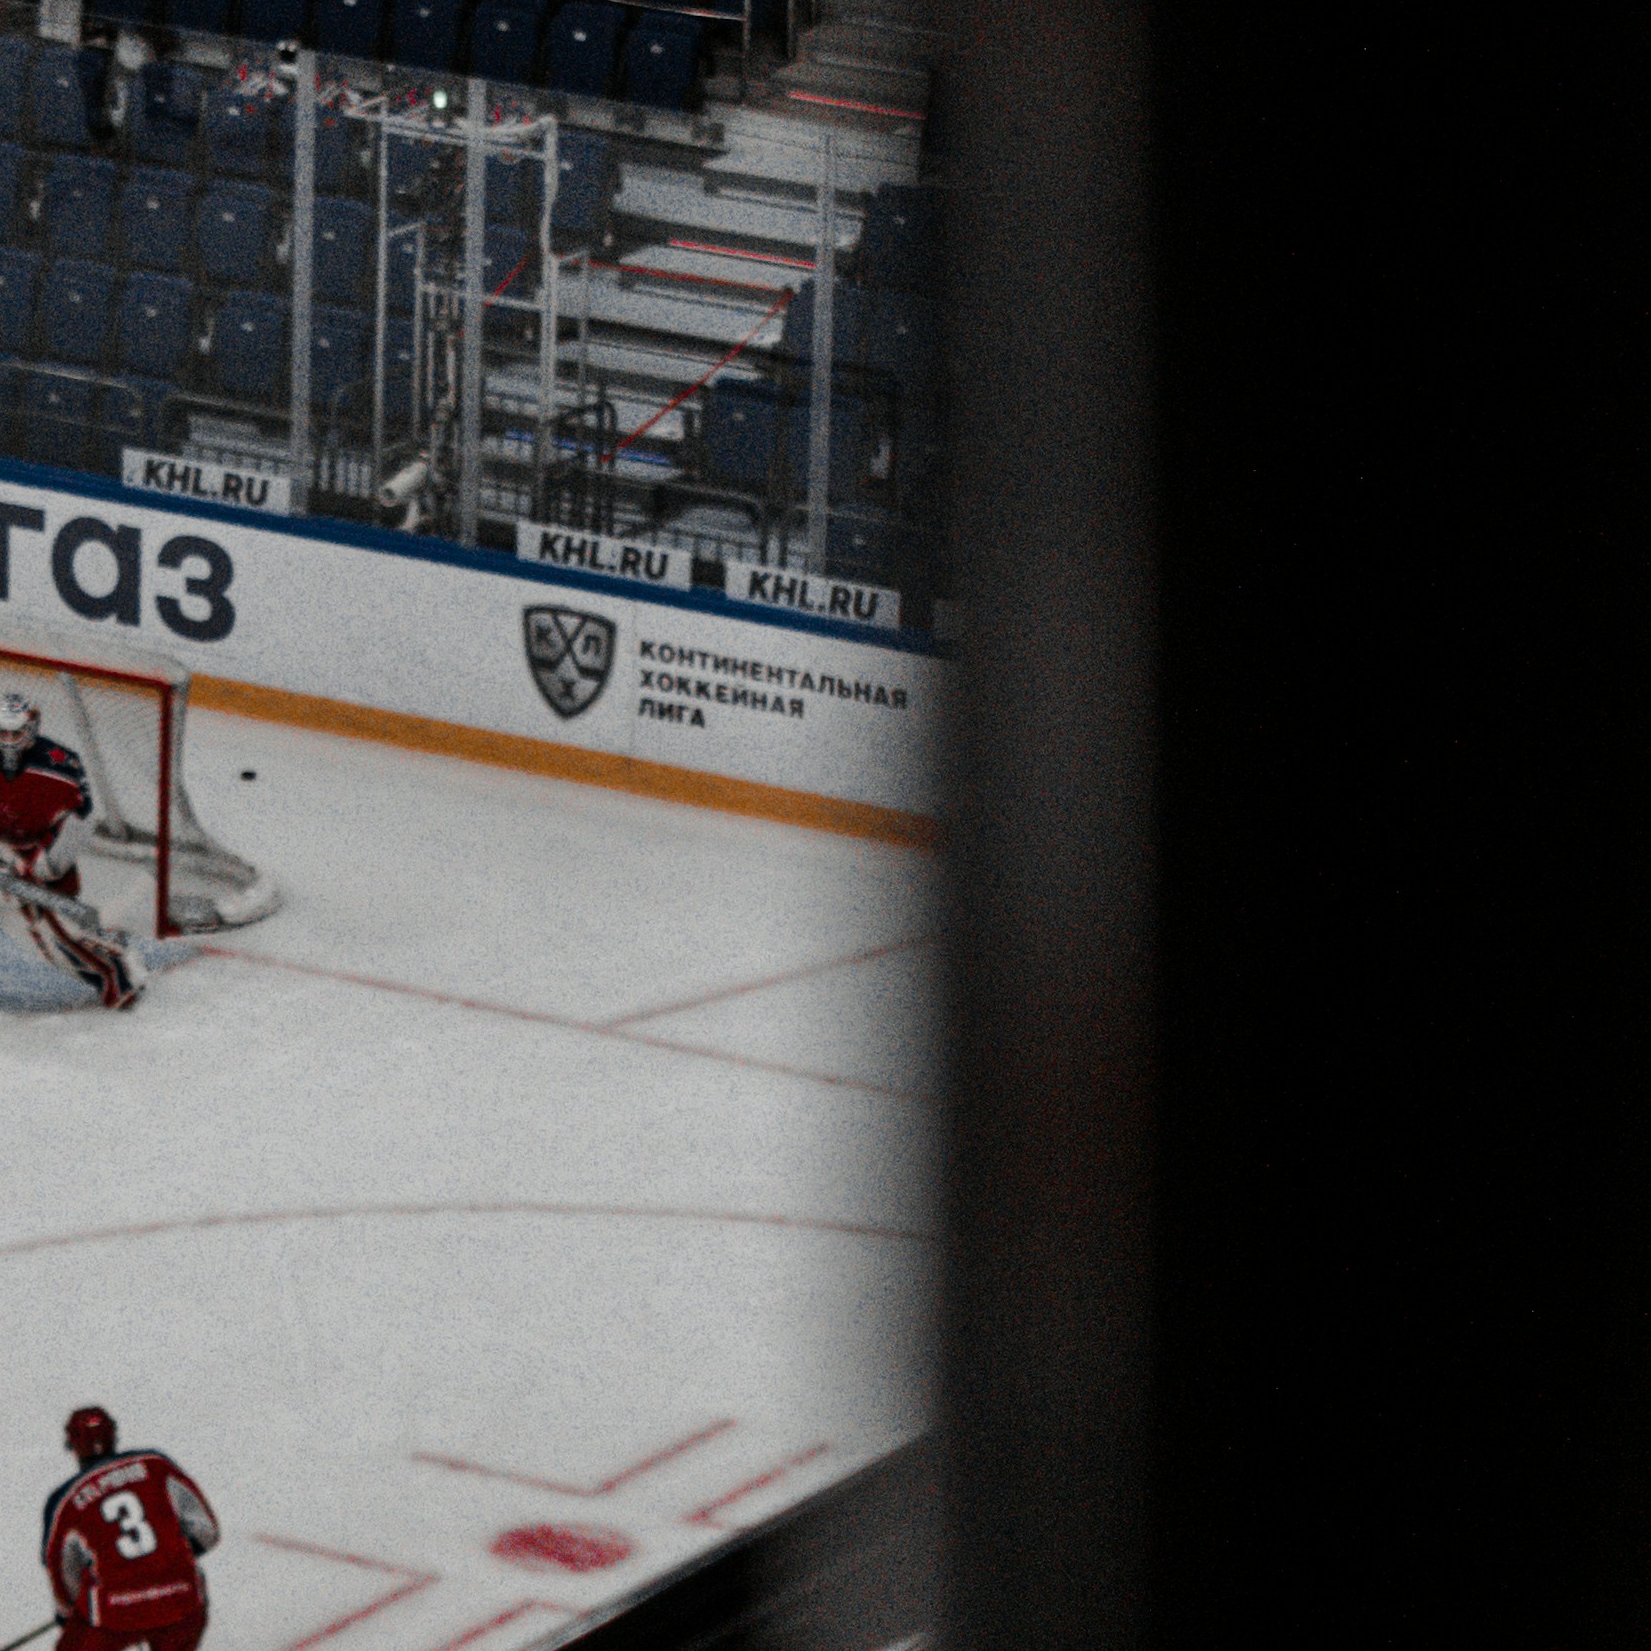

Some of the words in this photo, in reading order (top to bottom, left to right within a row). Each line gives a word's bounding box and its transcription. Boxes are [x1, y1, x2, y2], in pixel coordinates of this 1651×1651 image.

[141, 459, 270, 506] KHL.RU
[538, 530, 669, 580] KHL.RU
[748, 570, 880, 621] KHL.RU
[639, 639, 909, 710] КОНТИНЕНТАЛЬНАЯ
[638, 698, 706, 728] ЛИГА
[99, 1488, 159, 1561] 3
